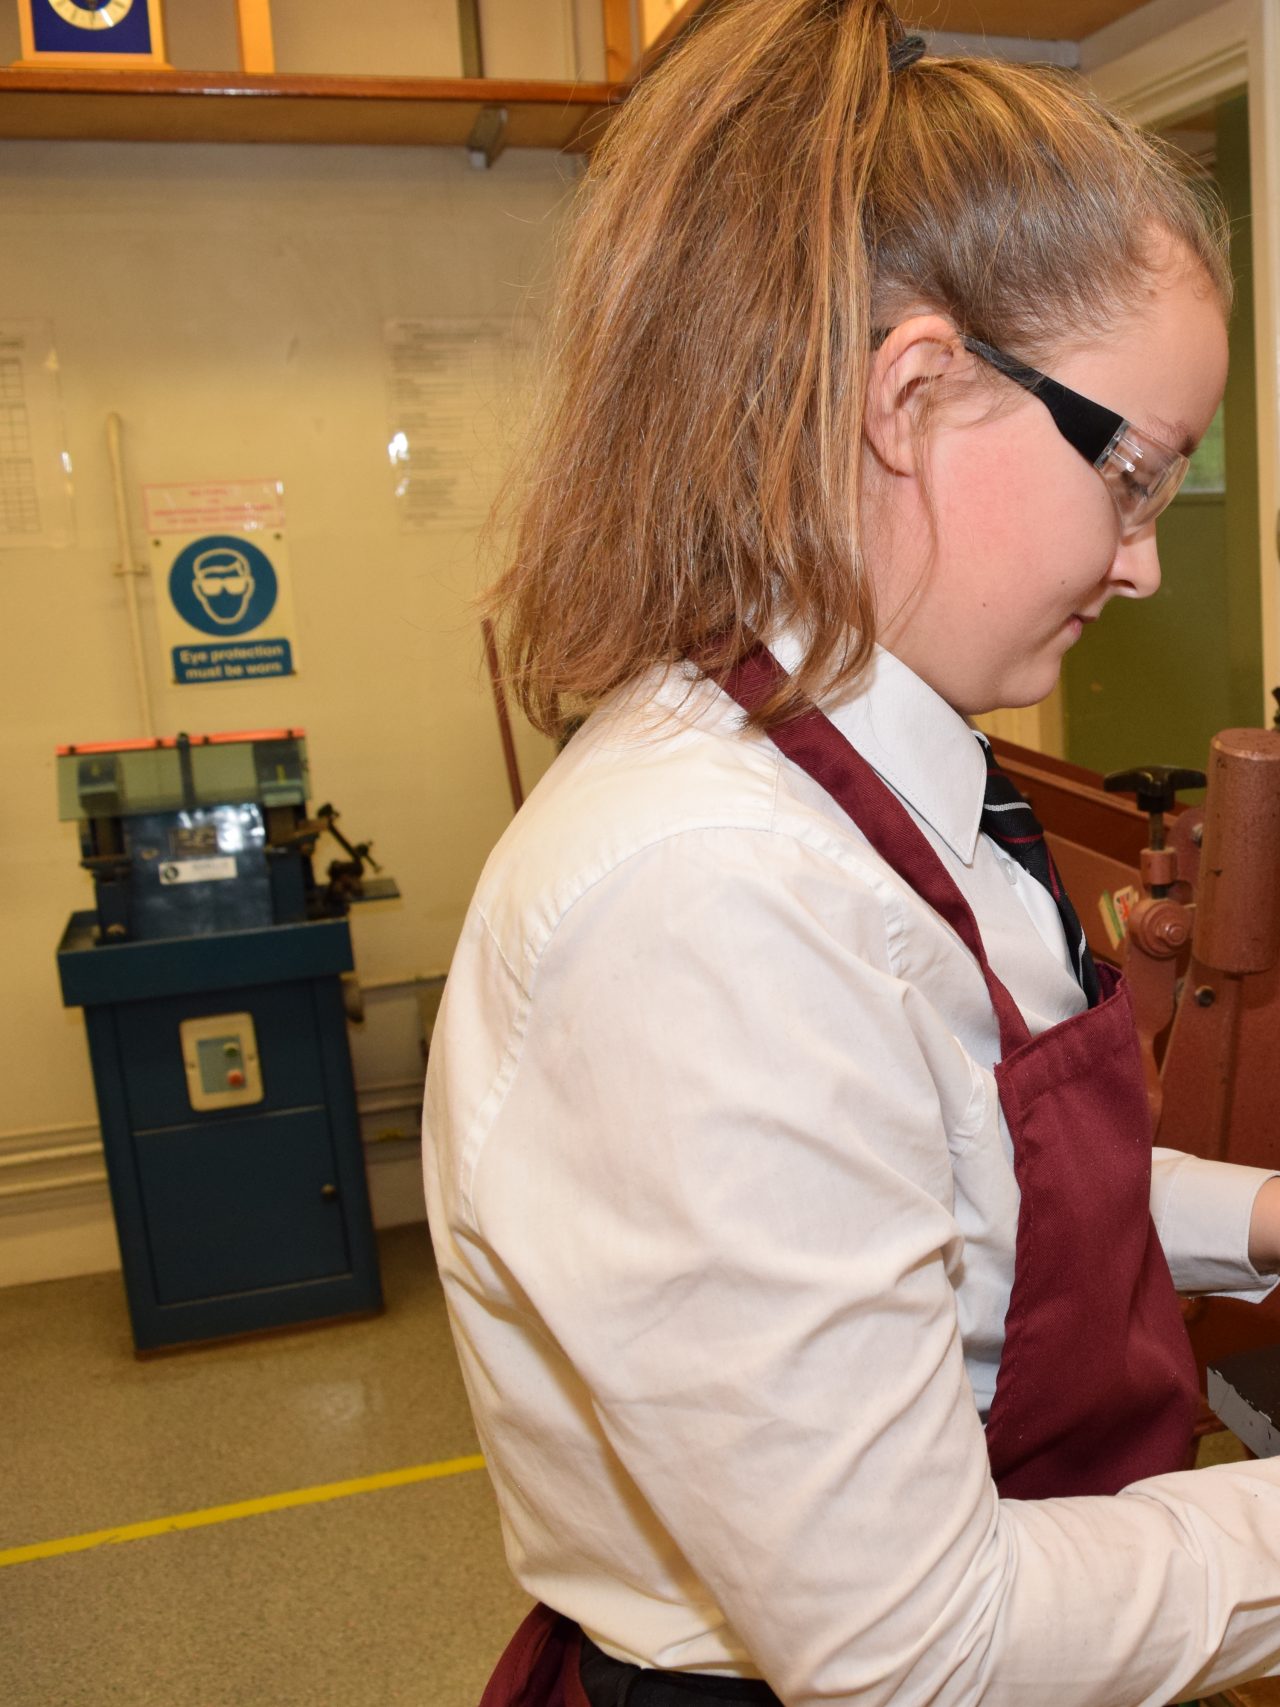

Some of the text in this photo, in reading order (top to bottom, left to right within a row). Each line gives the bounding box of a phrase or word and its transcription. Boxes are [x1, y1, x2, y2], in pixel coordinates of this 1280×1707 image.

[180, 645, 283, 665] Eye protection
[185, 662, 282, 679] must be worn
